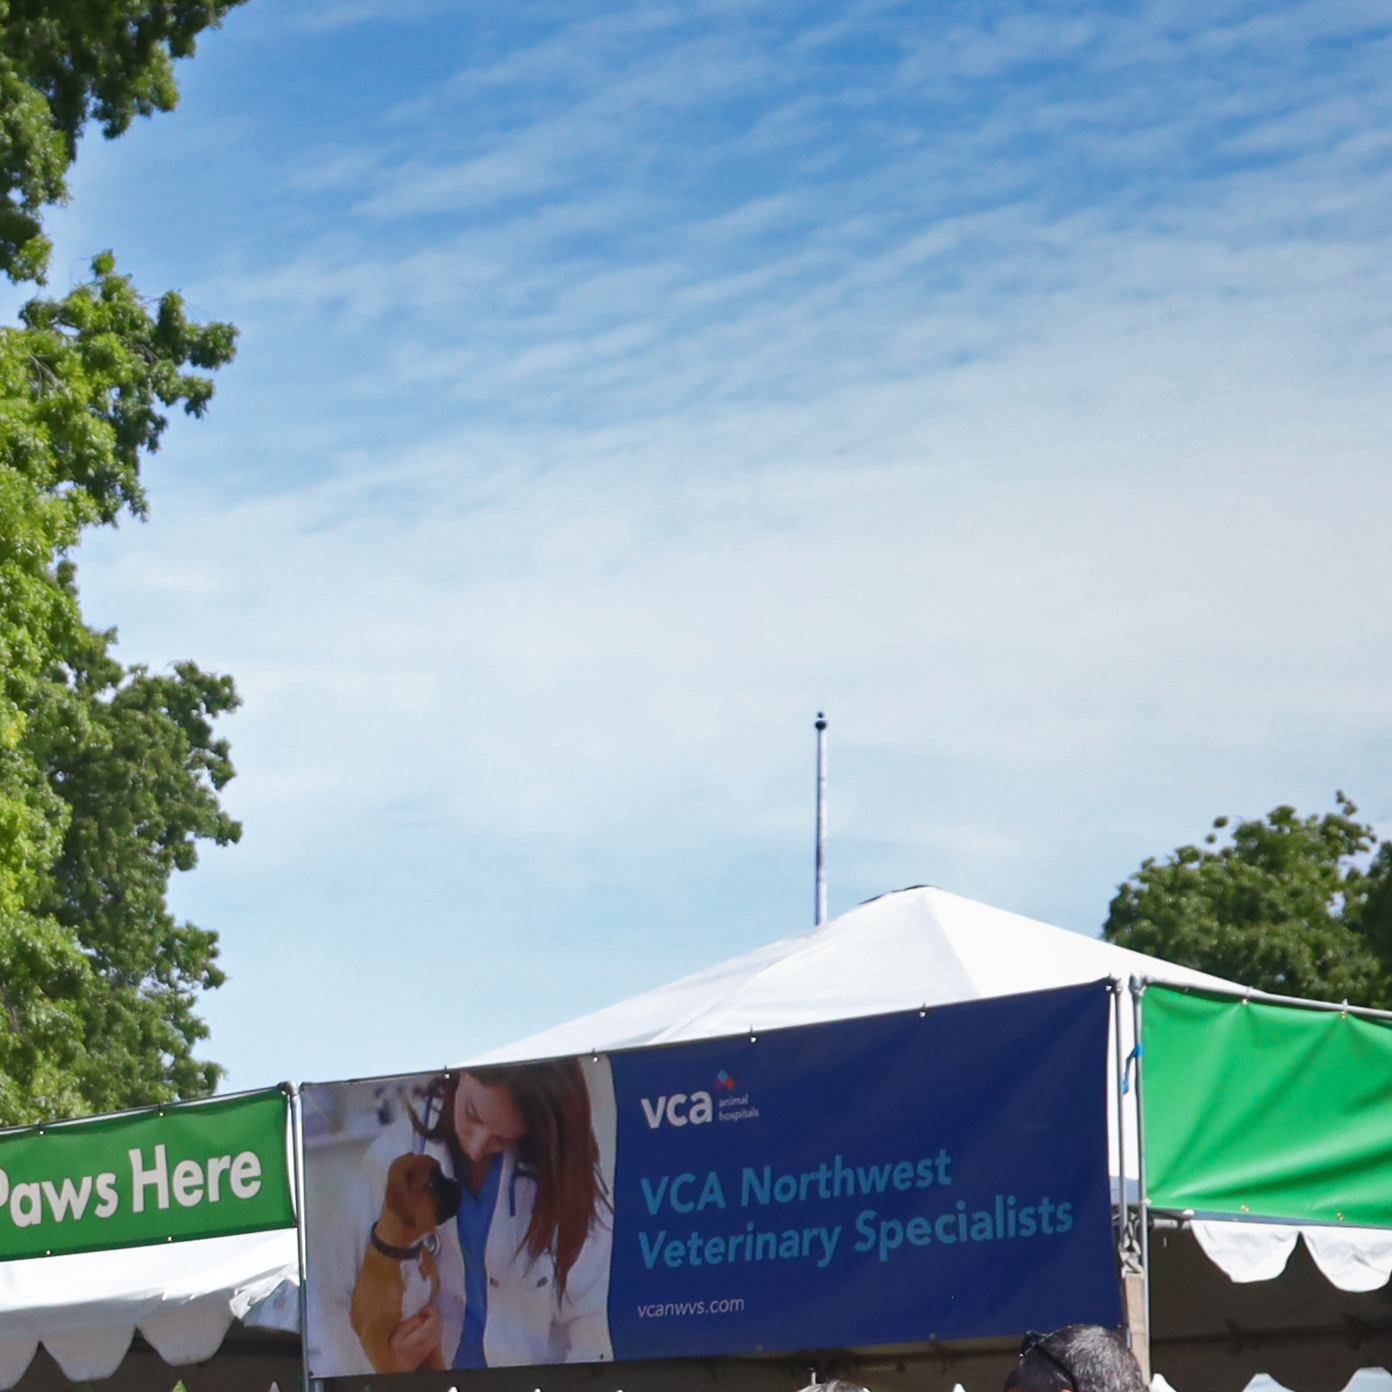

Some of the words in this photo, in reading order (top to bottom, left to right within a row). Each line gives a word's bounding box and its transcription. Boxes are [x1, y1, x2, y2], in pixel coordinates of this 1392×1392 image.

[640, 1091, 713, 1129] vca
[719, 1094, 749, 1107] animal
[719, 1107, 760, 1121] hospitals
[129, 1144, 262, 1213] Here
[640, 1172, 726, 1217] VCA
[741, 1148, 952, 1206] Northwest
[639, 1215, 842, 1272] Veterinary
[854, 1194, 1075, 1256] Specialists
[637, 1296, 744, 1319] vcanwvs.com
